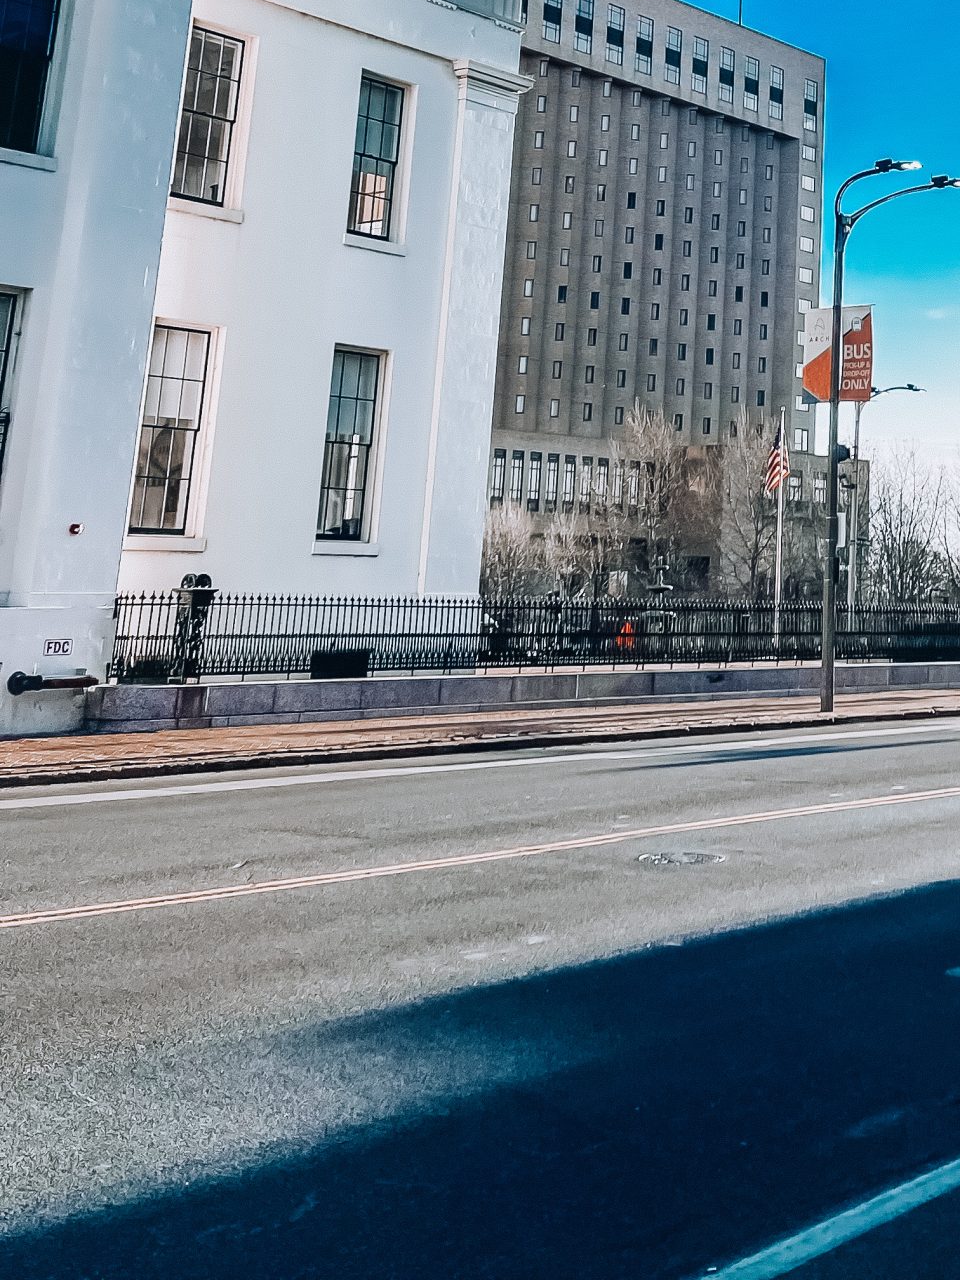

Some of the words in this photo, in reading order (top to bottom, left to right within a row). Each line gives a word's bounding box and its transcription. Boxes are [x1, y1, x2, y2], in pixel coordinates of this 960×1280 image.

[843, 343, 871, 360] BUS
[842, 379, 870, 390] ONLY
[46, 641, 70, 654] FDC
